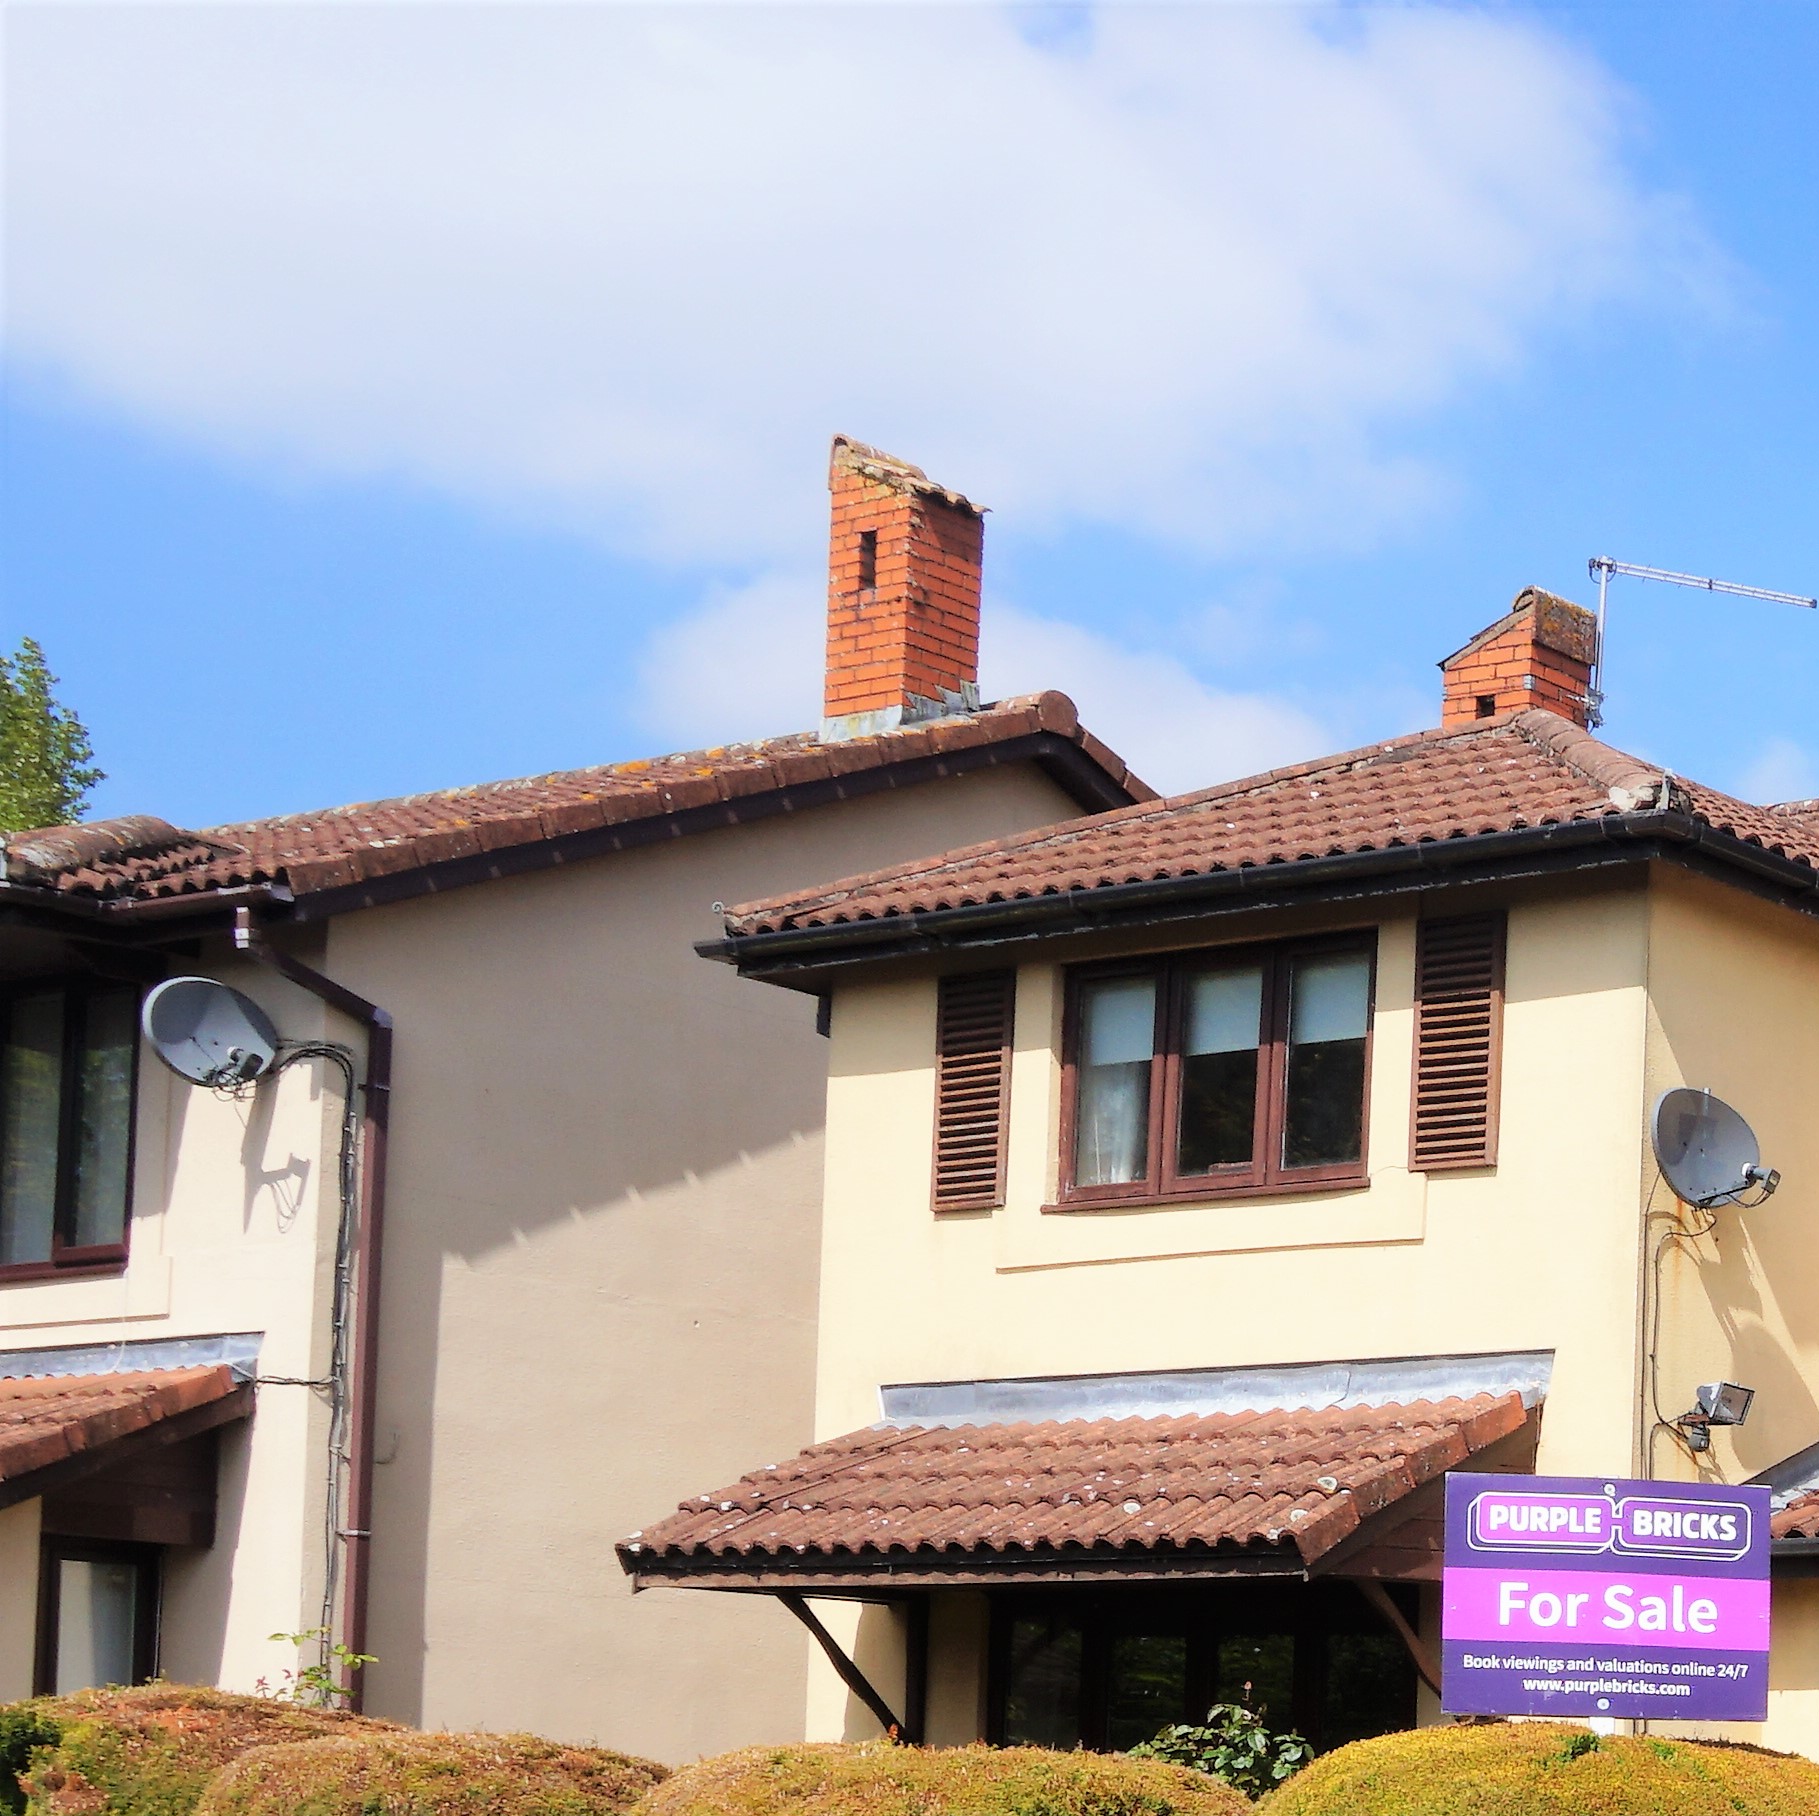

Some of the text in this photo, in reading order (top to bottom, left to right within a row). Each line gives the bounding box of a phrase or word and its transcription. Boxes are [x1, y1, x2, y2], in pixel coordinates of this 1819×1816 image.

[1489, 1505, 1737, 1540] PURPLE BRICKS
[1499, 1582, 1718, 1633] For Sale
[1464, 1655, 1748, 1679] Book viewings and valuations online 24/7
[1523, 1678, 1691, 1696] www.purplebricks.com
